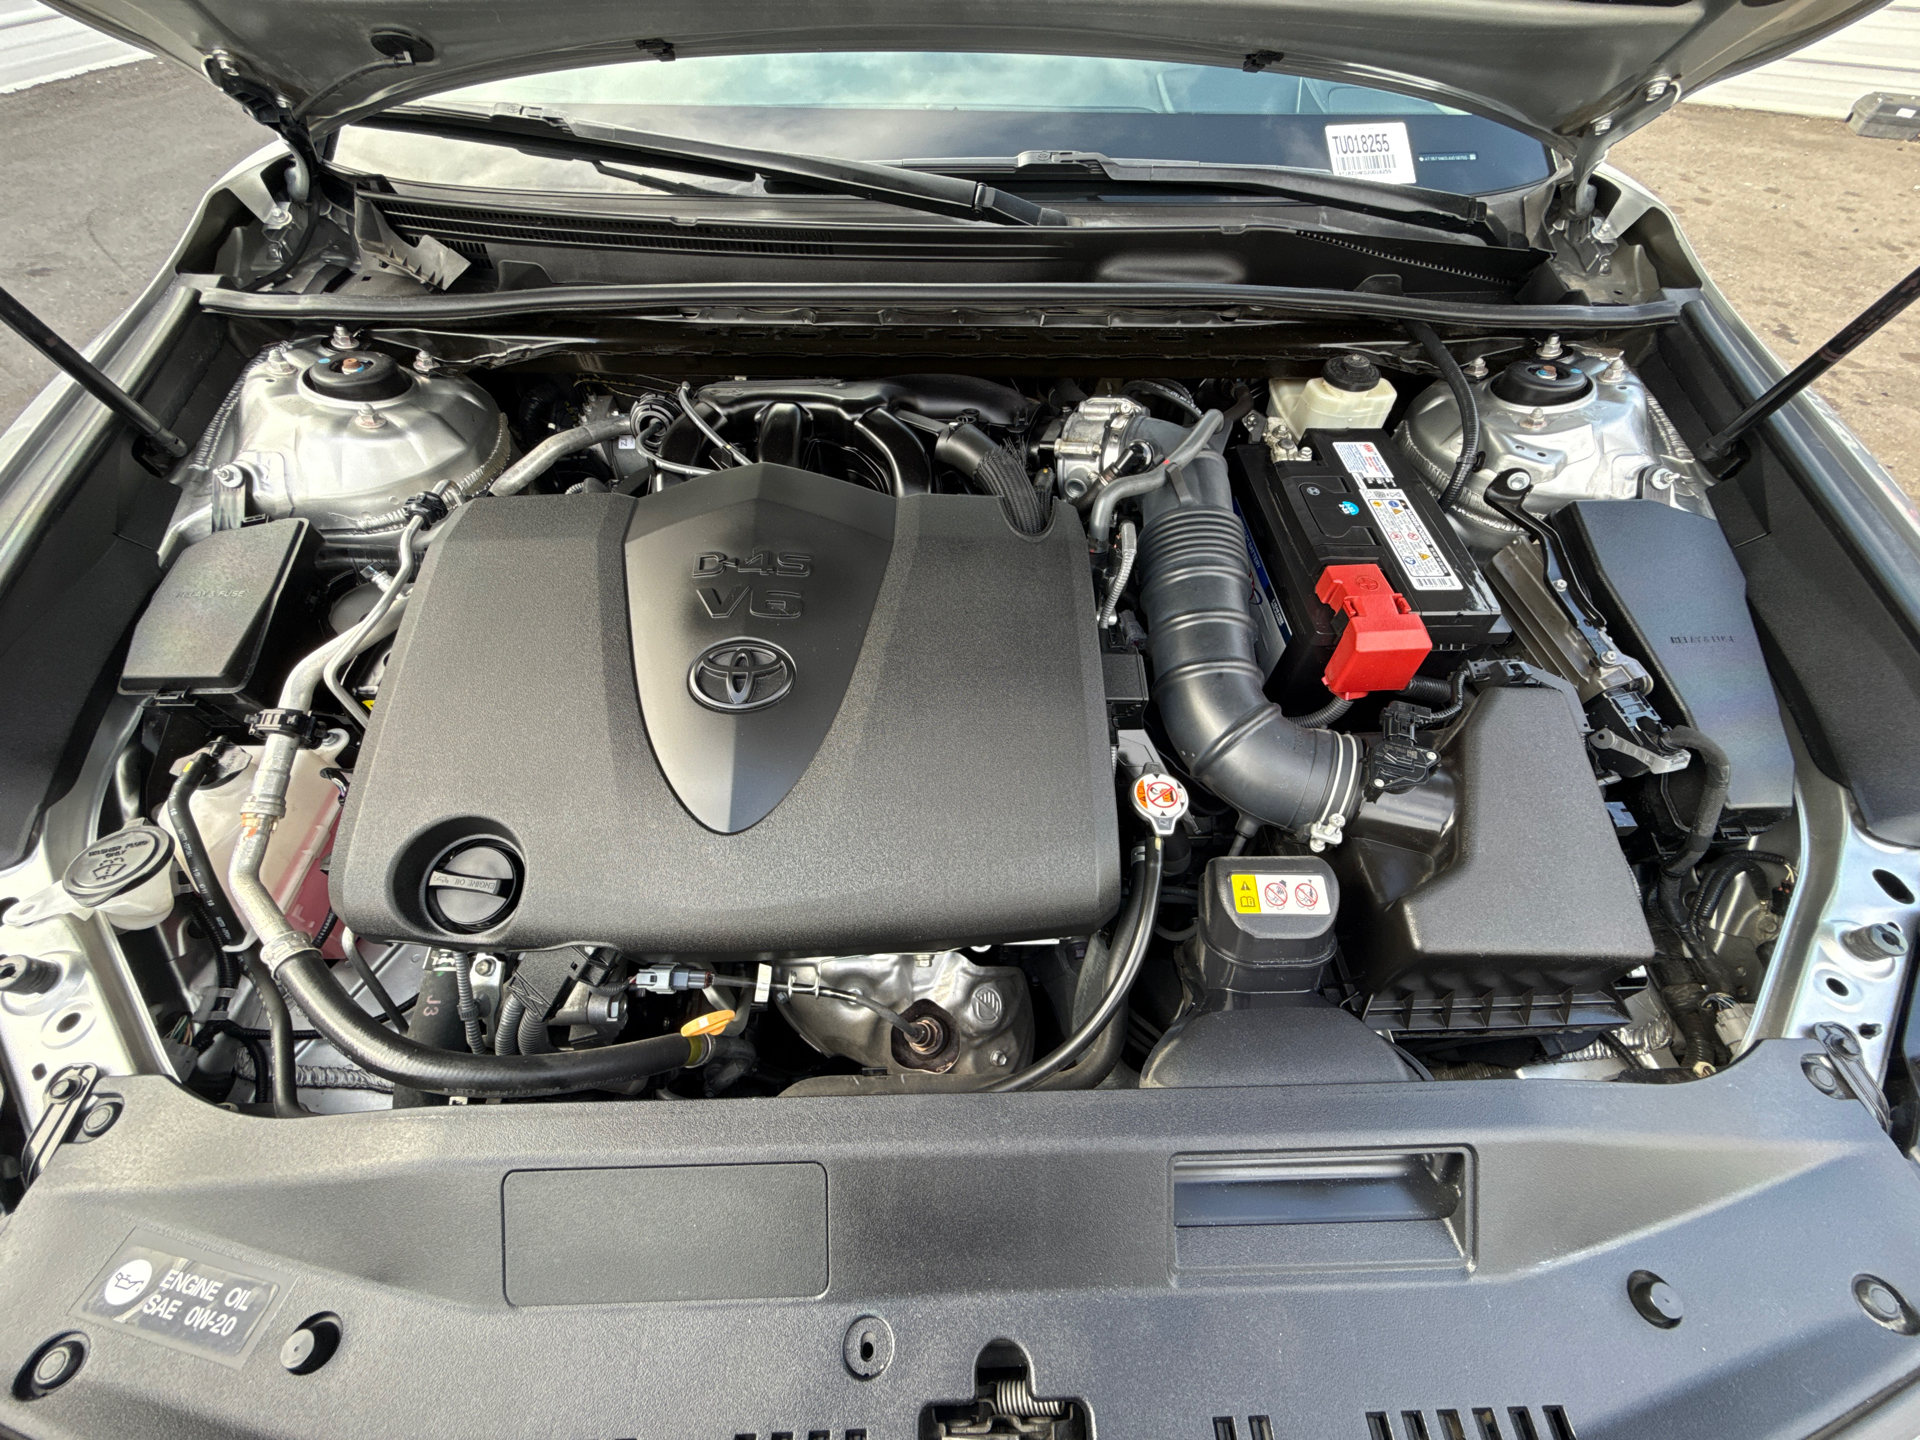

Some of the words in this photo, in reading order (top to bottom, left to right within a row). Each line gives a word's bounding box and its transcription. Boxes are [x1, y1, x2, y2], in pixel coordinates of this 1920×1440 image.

[1332, 133, 1390, 155] TU018255
[692, 551, 812, 578] D-4S
[1247, 540, 1261, 569] BATTERY
[218, 590, 246, 598] FUSE
[696, 585, 803, 619] V6
[453, 878, 466, 886] OIL
[468, 881, 496, 890] ENGINE
[423, 993, 442, 1017] J3
[160, 1269, 223, 1301] ENGINE
[225, 1287, 251, 1311] OIL
[143, 1294, 182, 1320] SAE
[184, 1306, 237, 1336] 0W-20
